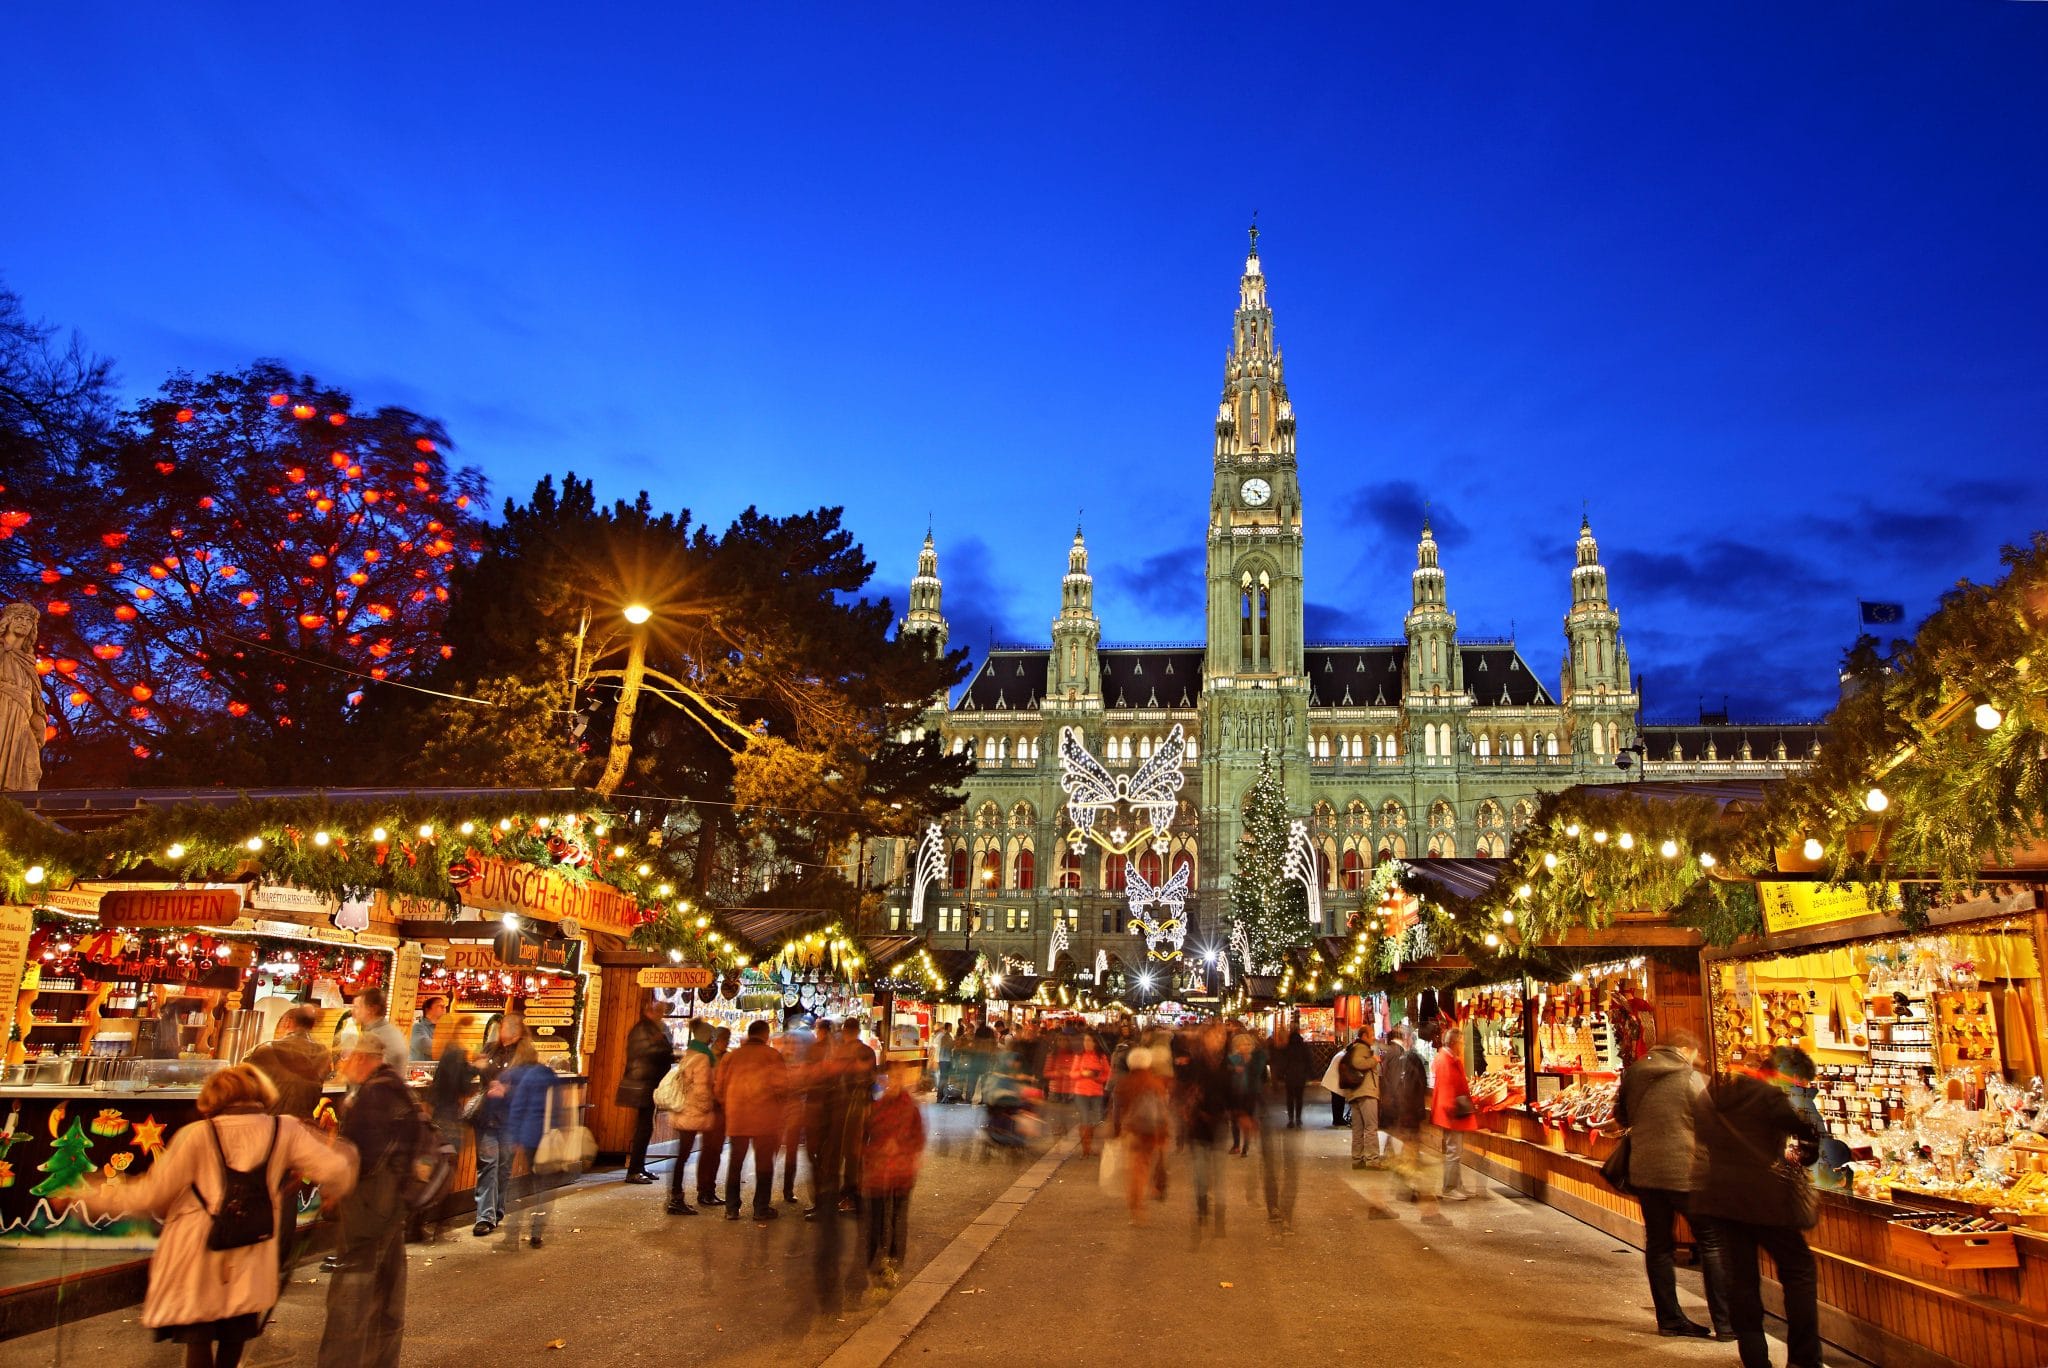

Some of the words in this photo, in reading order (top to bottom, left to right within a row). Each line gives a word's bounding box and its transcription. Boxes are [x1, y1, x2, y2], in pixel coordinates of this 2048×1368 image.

[111, 892, 225, 921] GLÜHWEIN
[518, 936, 539, 966] Energy
[541, 940, 566, 965] Punsch
[643, 971, 707, 984] BEERENPUNSCH
